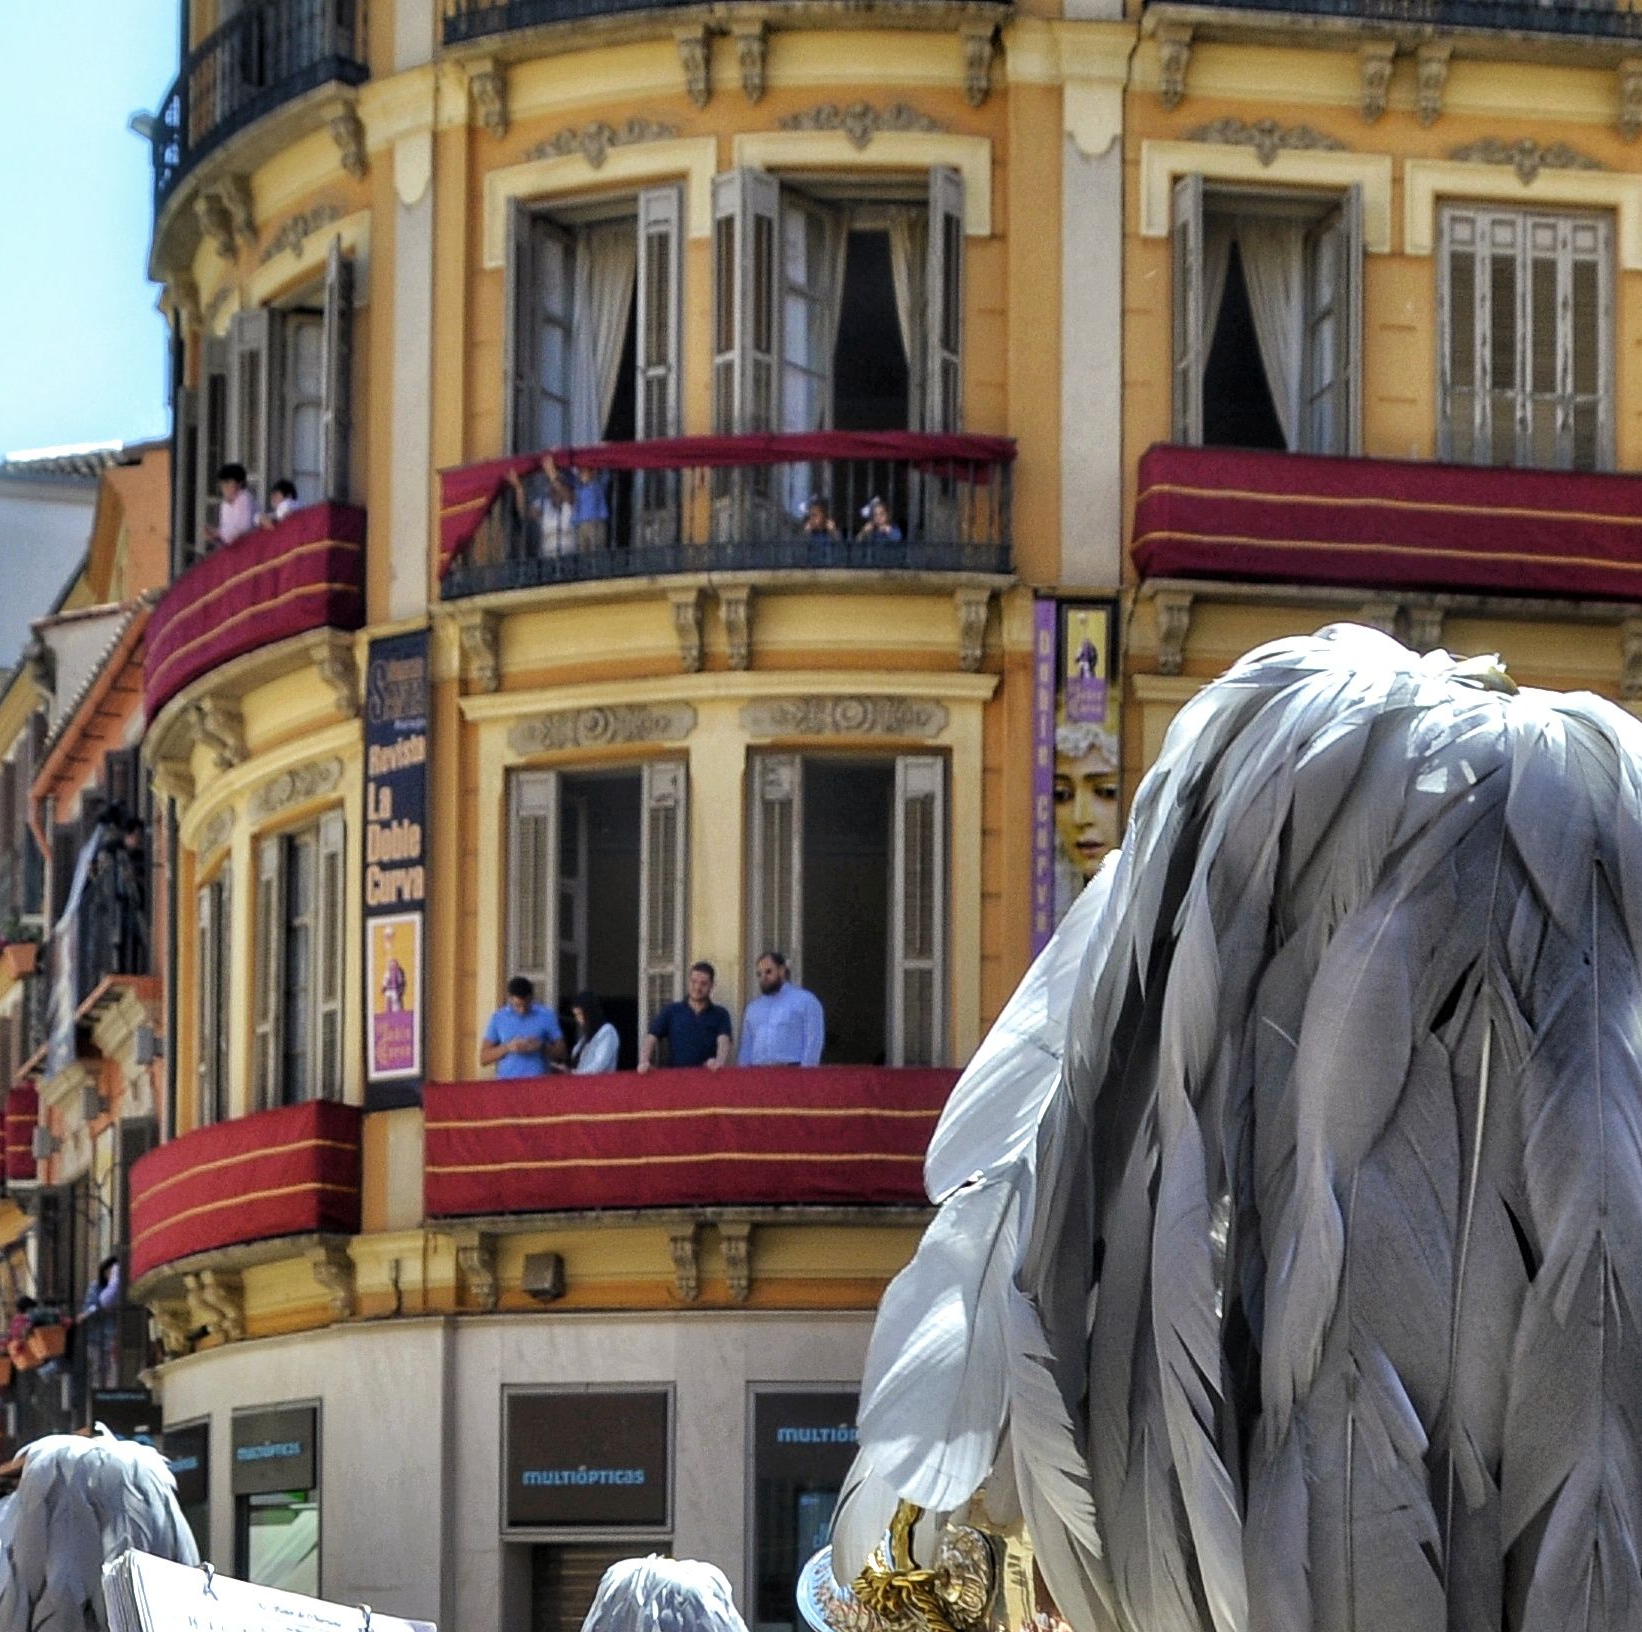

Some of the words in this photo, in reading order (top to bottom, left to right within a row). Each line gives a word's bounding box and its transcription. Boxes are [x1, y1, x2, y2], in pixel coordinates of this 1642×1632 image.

[368, 735, 426, 777] Revista
[367, 781, 392, 821] La
[367, 818, 422, 863] Doble
[365, 864, 425, 907] Curva
